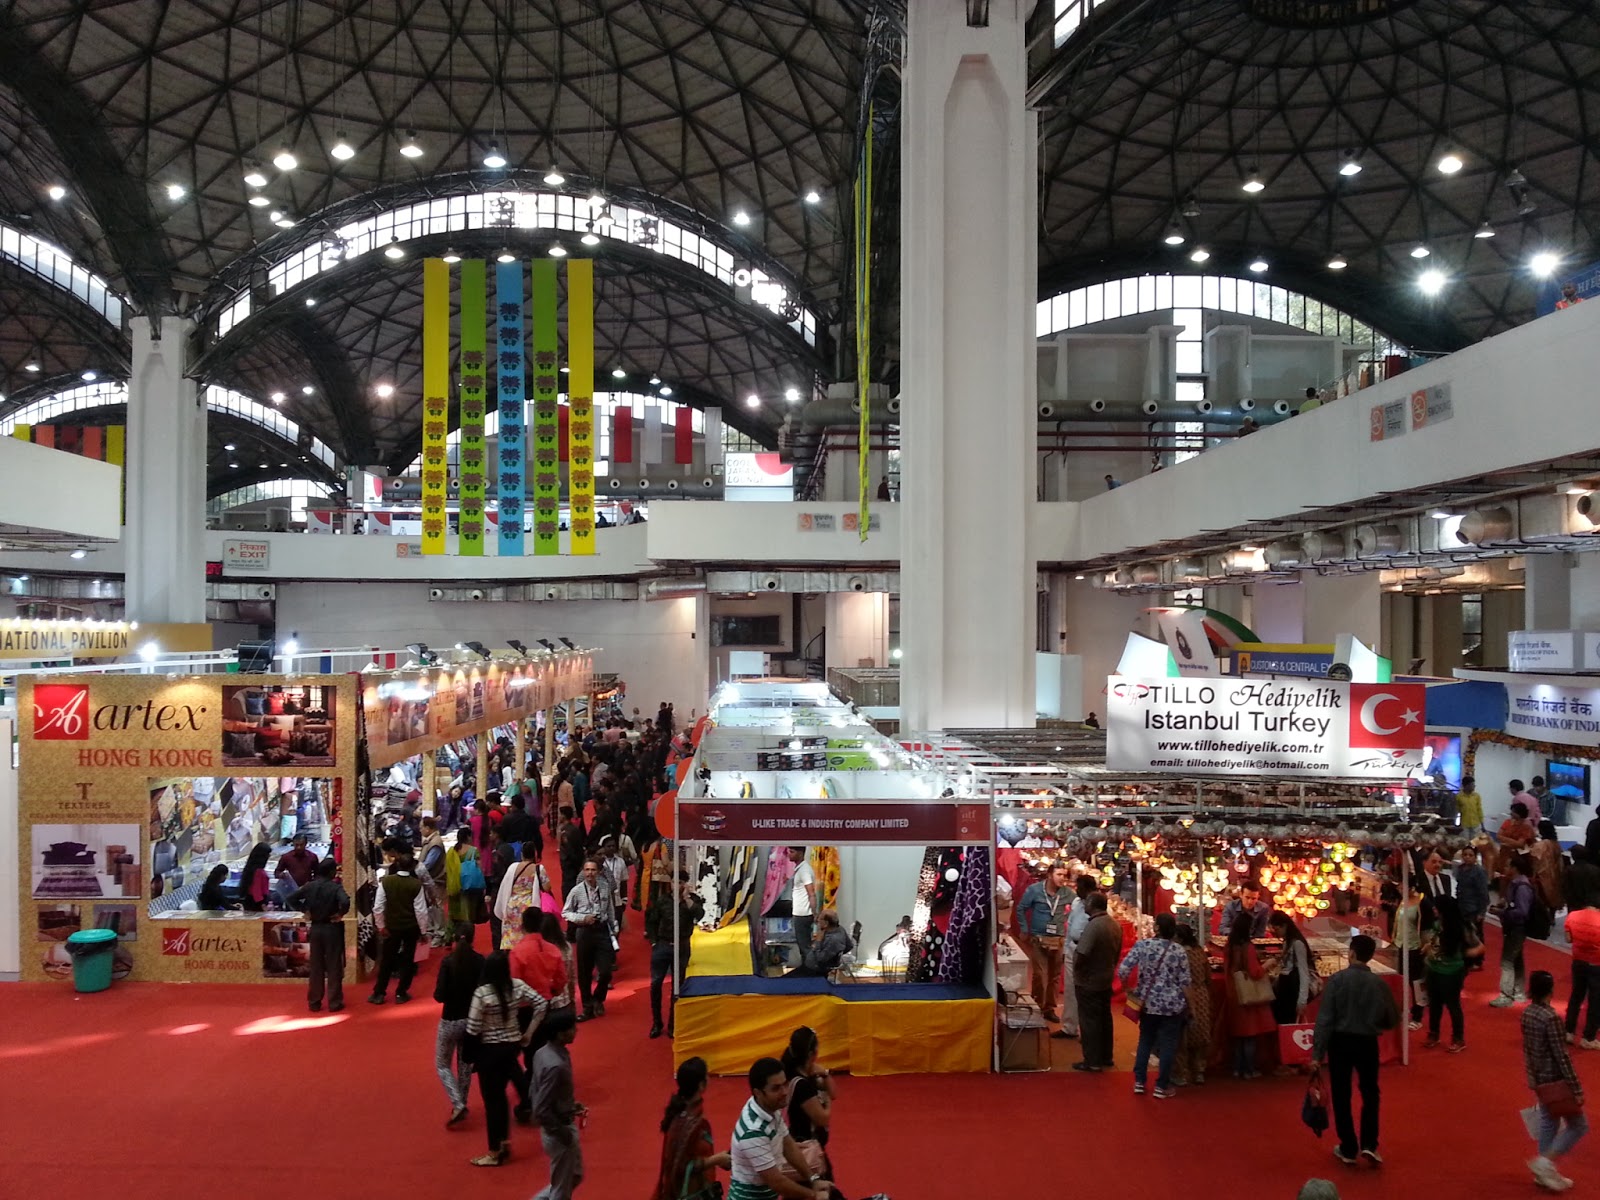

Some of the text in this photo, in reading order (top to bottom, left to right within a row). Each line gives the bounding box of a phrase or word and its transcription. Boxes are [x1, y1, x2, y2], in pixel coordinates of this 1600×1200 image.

[0, 630, 128, 650] ATIONAL PAVILION
[1250, 660, 1279, 671] CUSTOMS
[1279, 661, 1286, 671] &
[1286, 661, 1320, 673] CENTRAL
[1230, 682, 1342, 714] Hediyelik
[1569, 697, 1593, 716] बैंक
[93, 699, 207, 731] artex
[1145, 709, 1332, 738] Istanbul Turkey
[1536, 716, 1560, 729] BANK
[1560, 718, 1574, 730] OF
[1157, 740, 1324, 755] www.tillohediyelik.com.tr
[78, 748, 214, 768] HONG KONG
[1150, 758, 1330, 771] email: tillohediyelik@hotmail.com
[75, 782, 94, 800] T
[57, 801, 111, 810] TEXTURES
[752, 818, 909, 829] U-LIKE TRADE & INDUSTRY COMPANY LIMITED
[191, 936, 247, 953] artex
[184, 960, 250, 970] HONG KONG
